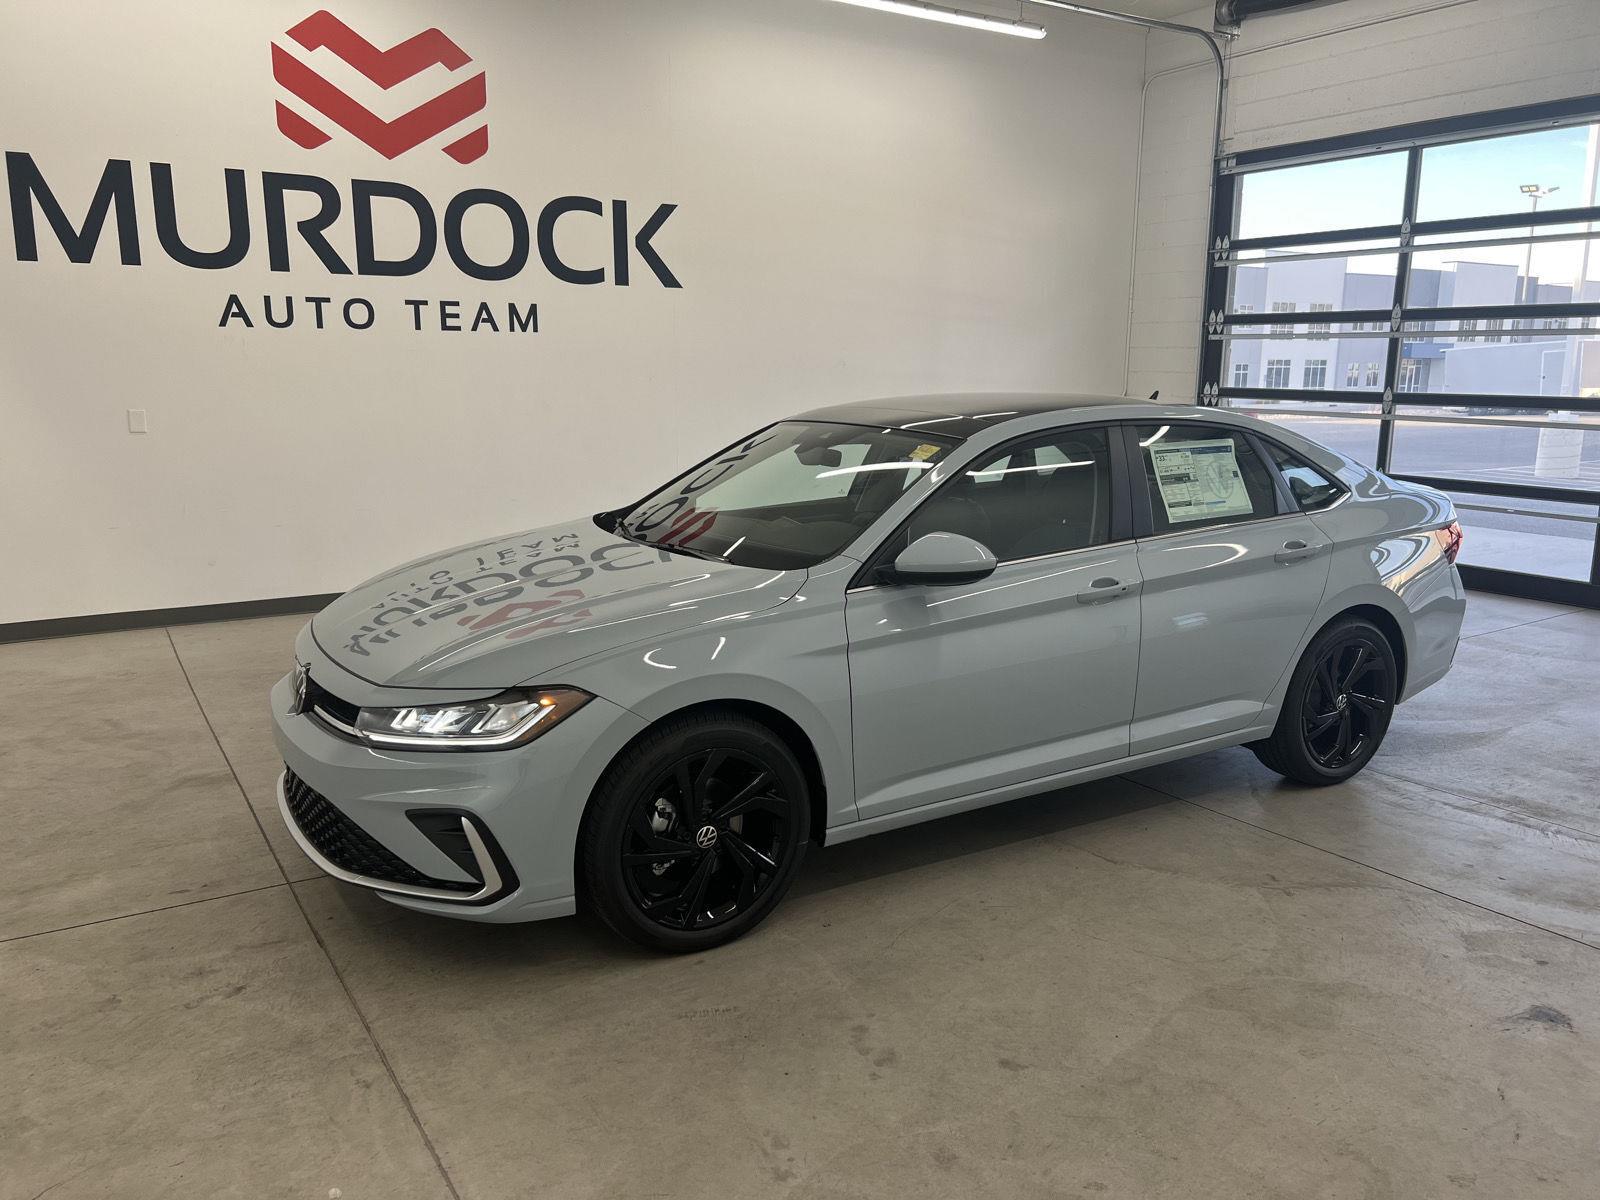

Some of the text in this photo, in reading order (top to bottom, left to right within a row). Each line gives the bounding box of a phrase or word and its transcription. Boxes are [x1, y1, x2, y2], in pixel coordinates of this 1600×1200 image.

[5, 150, 683, 289] MURDOCK
[218, 294, 540, 333] AUTO TEAM
